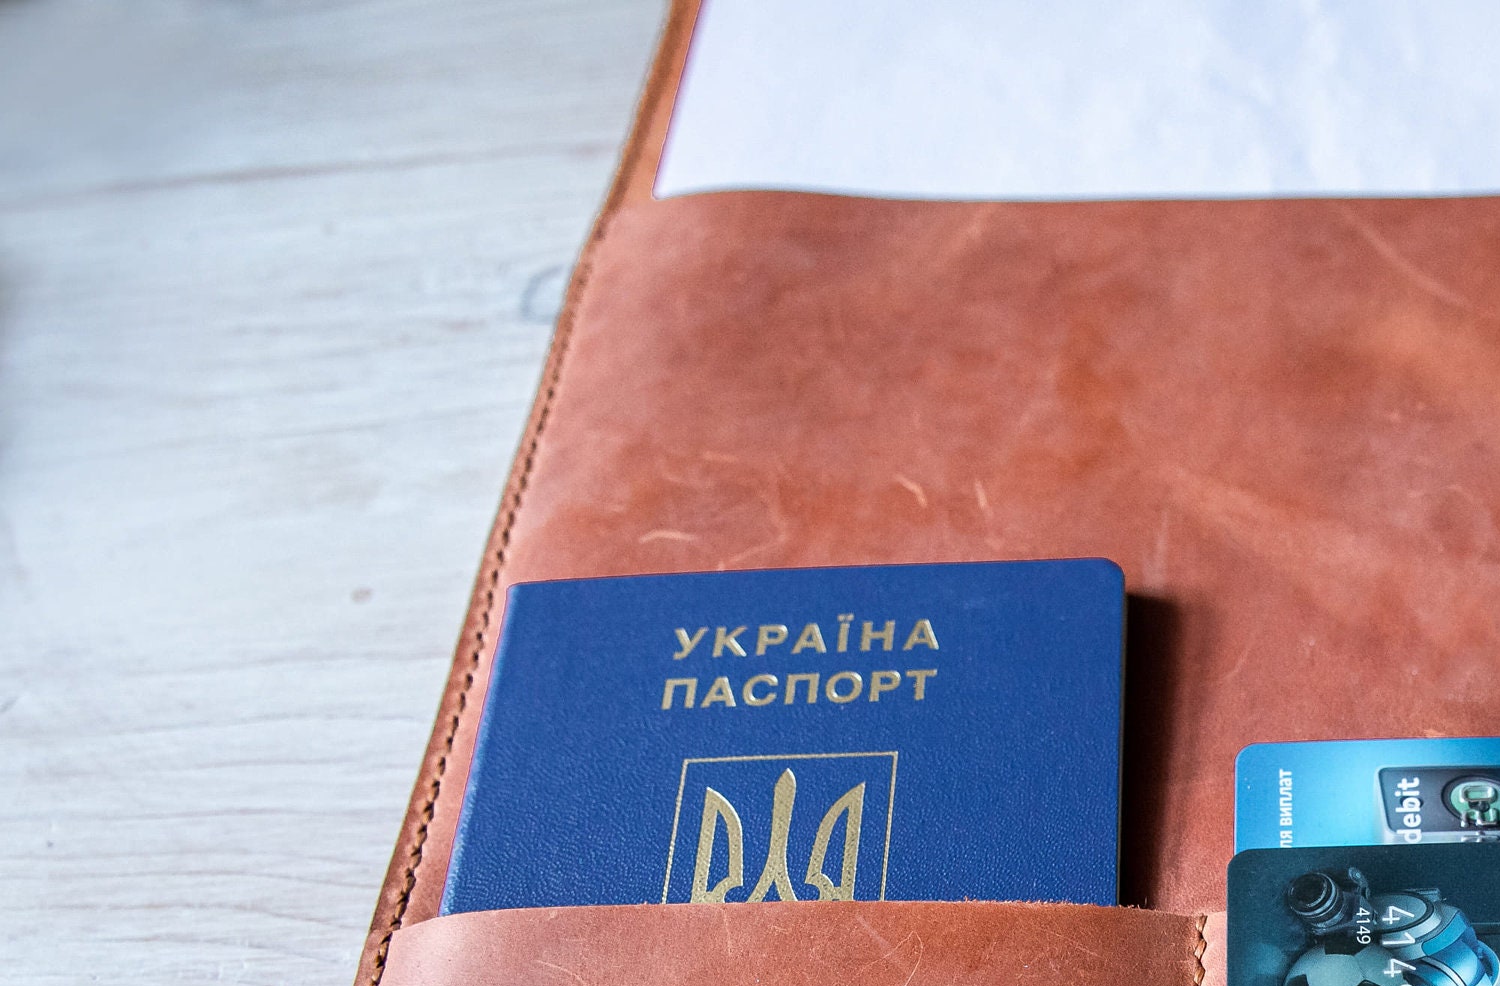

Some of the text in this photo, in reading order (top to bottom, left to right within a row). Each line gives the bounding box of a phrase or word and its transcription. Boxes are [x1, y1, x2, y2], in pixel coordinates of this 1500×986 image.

[672, 613, 939, 660] УКРАЇНА
[661, 669, 938, 710] ПАСПОРТ
[1394, 777, 1423, 843] debit
[1280, 830, 1293, 848] ля
[1356, 906, 1372, 945] 4149
